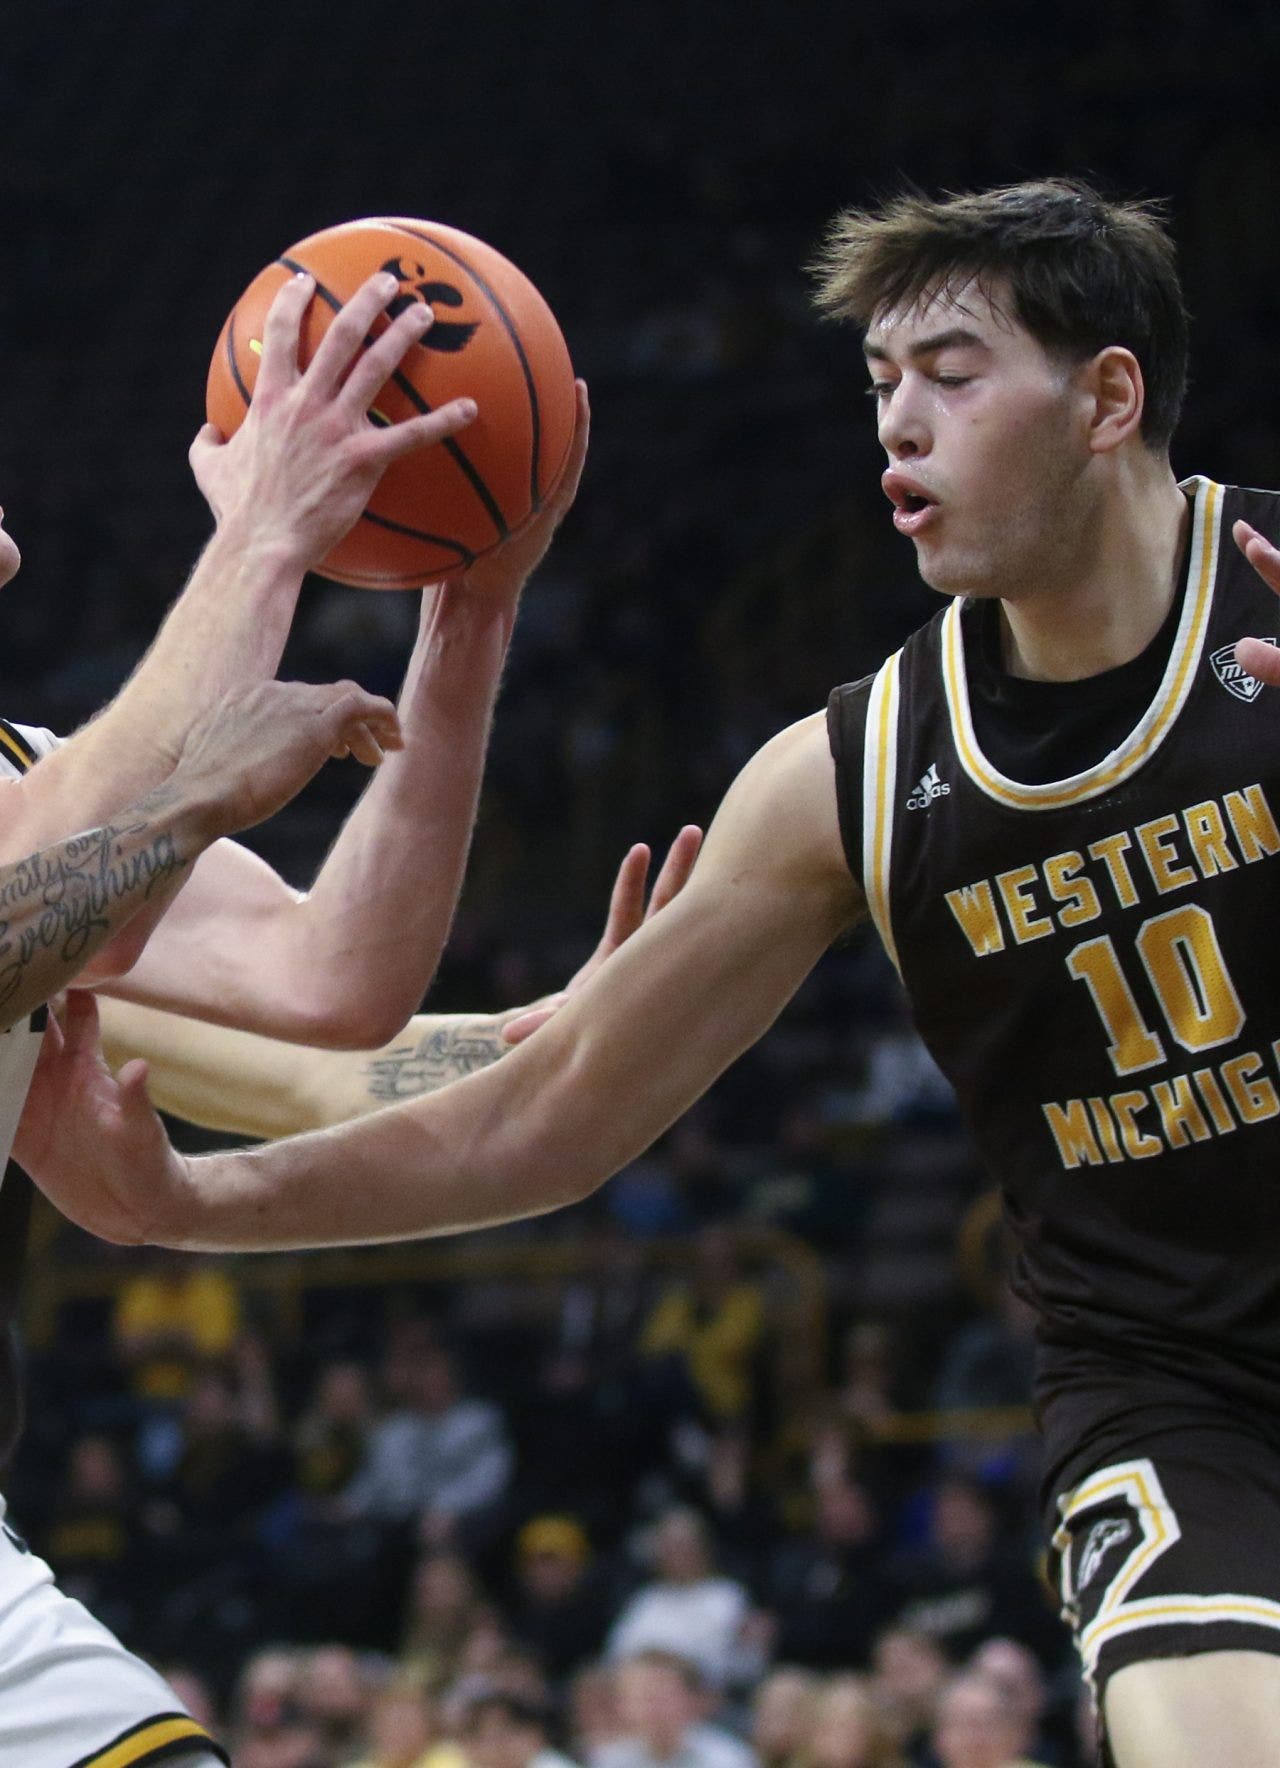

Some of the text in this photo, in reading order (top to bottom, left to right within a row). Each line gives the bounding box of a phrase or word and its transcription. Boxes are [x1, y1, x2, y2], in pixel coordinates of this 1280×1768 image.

[906, 783, 950, 810] adas
[944, 783, 1280, 957] WESTERN
[1065, 903, 1246, 1076] 10
[1041, 1039, 1280, 1171] MICHIG
